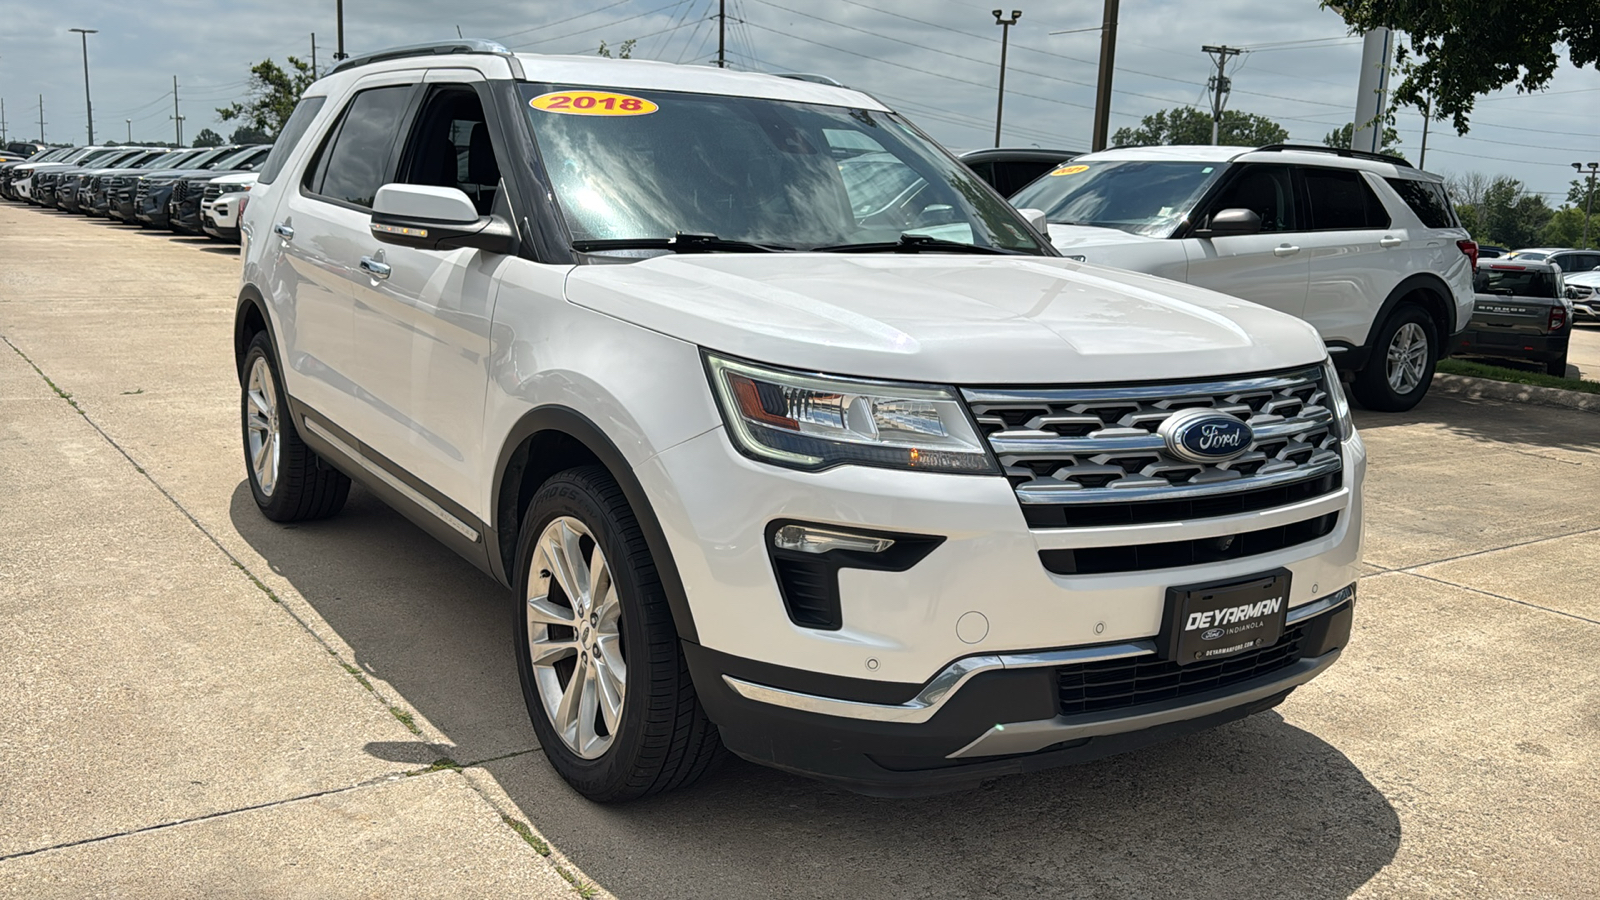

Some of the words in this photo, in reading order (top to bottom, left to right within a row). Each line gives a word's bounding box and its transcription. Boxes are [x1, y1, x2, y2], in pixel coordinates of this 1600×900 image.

[546, 96, 643, 111] 2018
[1199, 423, 1242, 450] Ford
[1184, 596, 1282, 631] DEYARMAN
[1226, 621, 1264, 635] INDIANOLA
